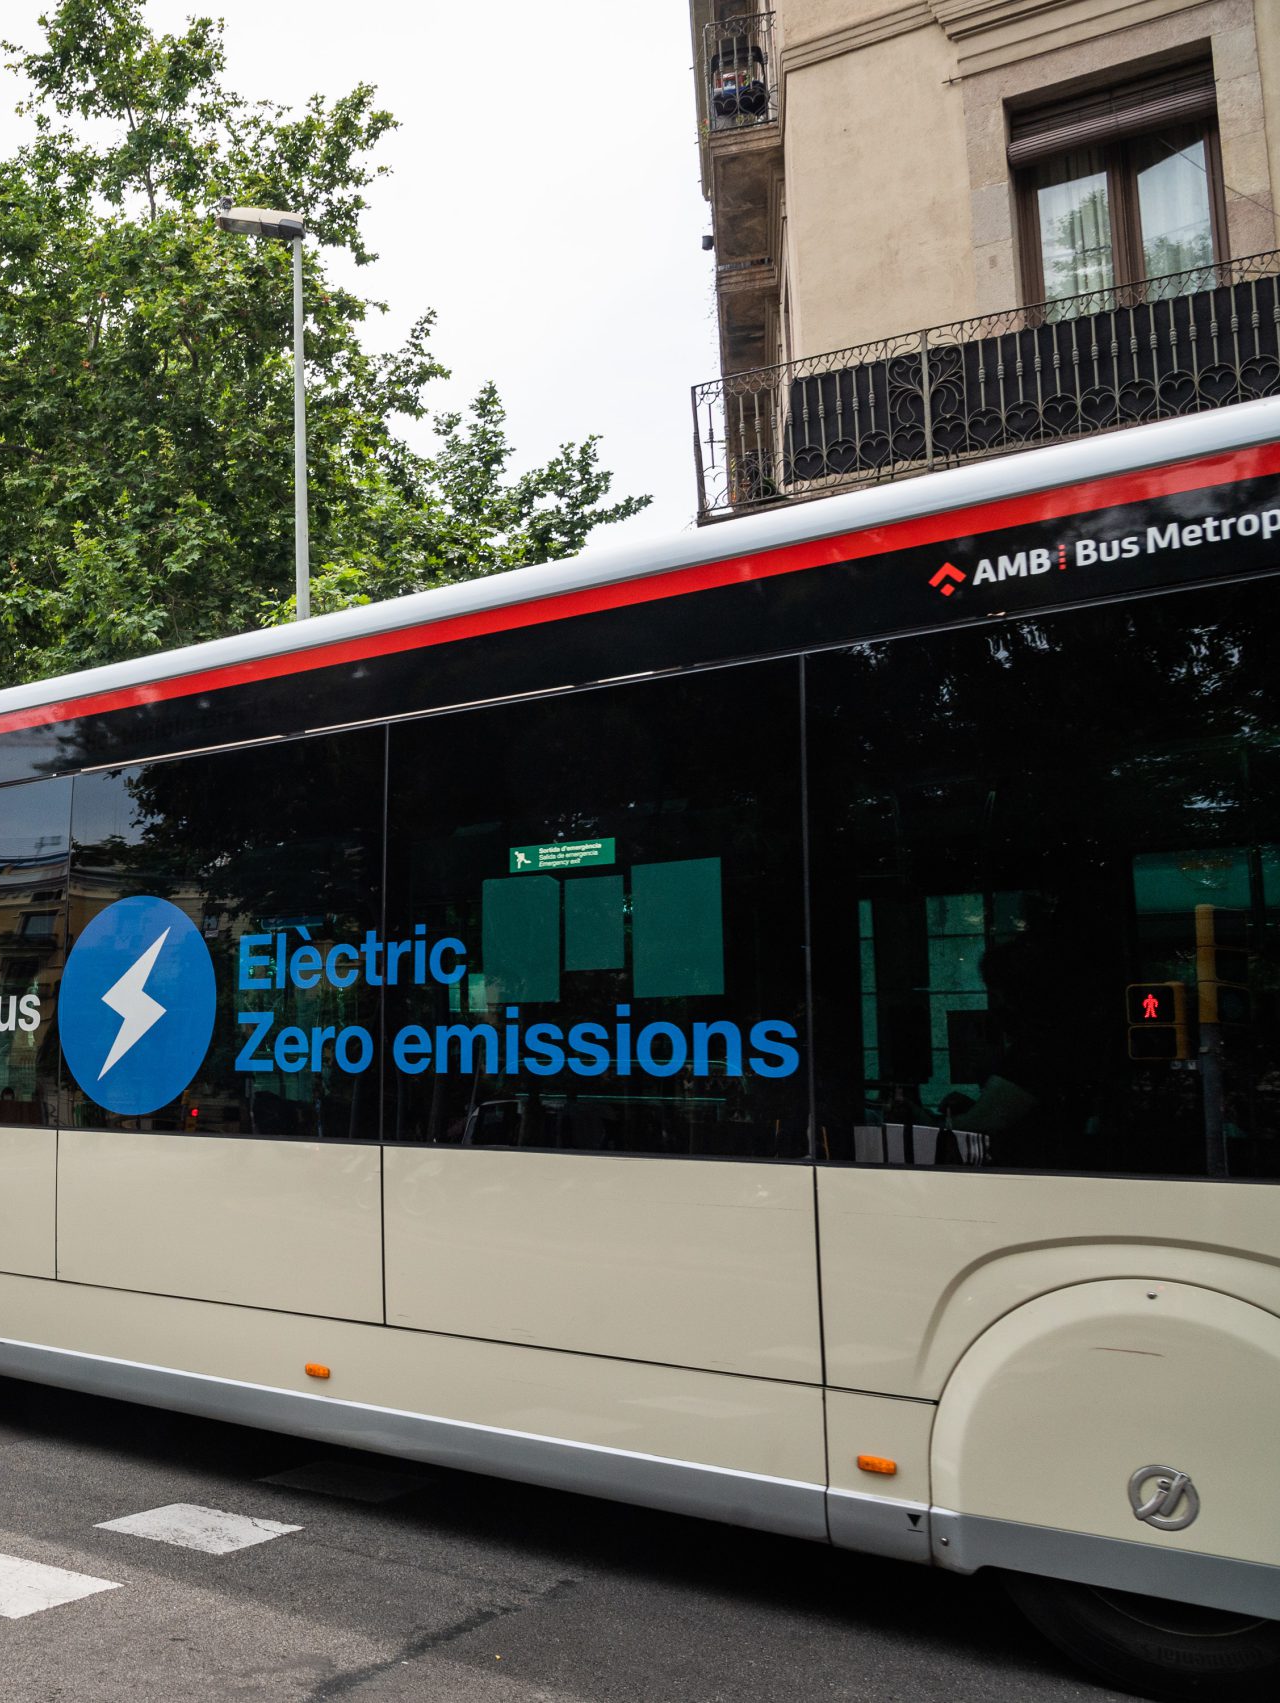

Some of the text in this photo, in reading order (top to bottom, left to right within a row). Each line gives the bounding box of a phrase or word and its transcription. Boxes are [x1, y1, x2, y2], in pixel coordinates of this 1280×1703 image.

[972, 548, 1051, 586] AMB
[1075, 536, 1139, 567] Bus
[238, 924, 467, 990] Elèctric
[235, 1004, 800, 1078] Zero emissions
